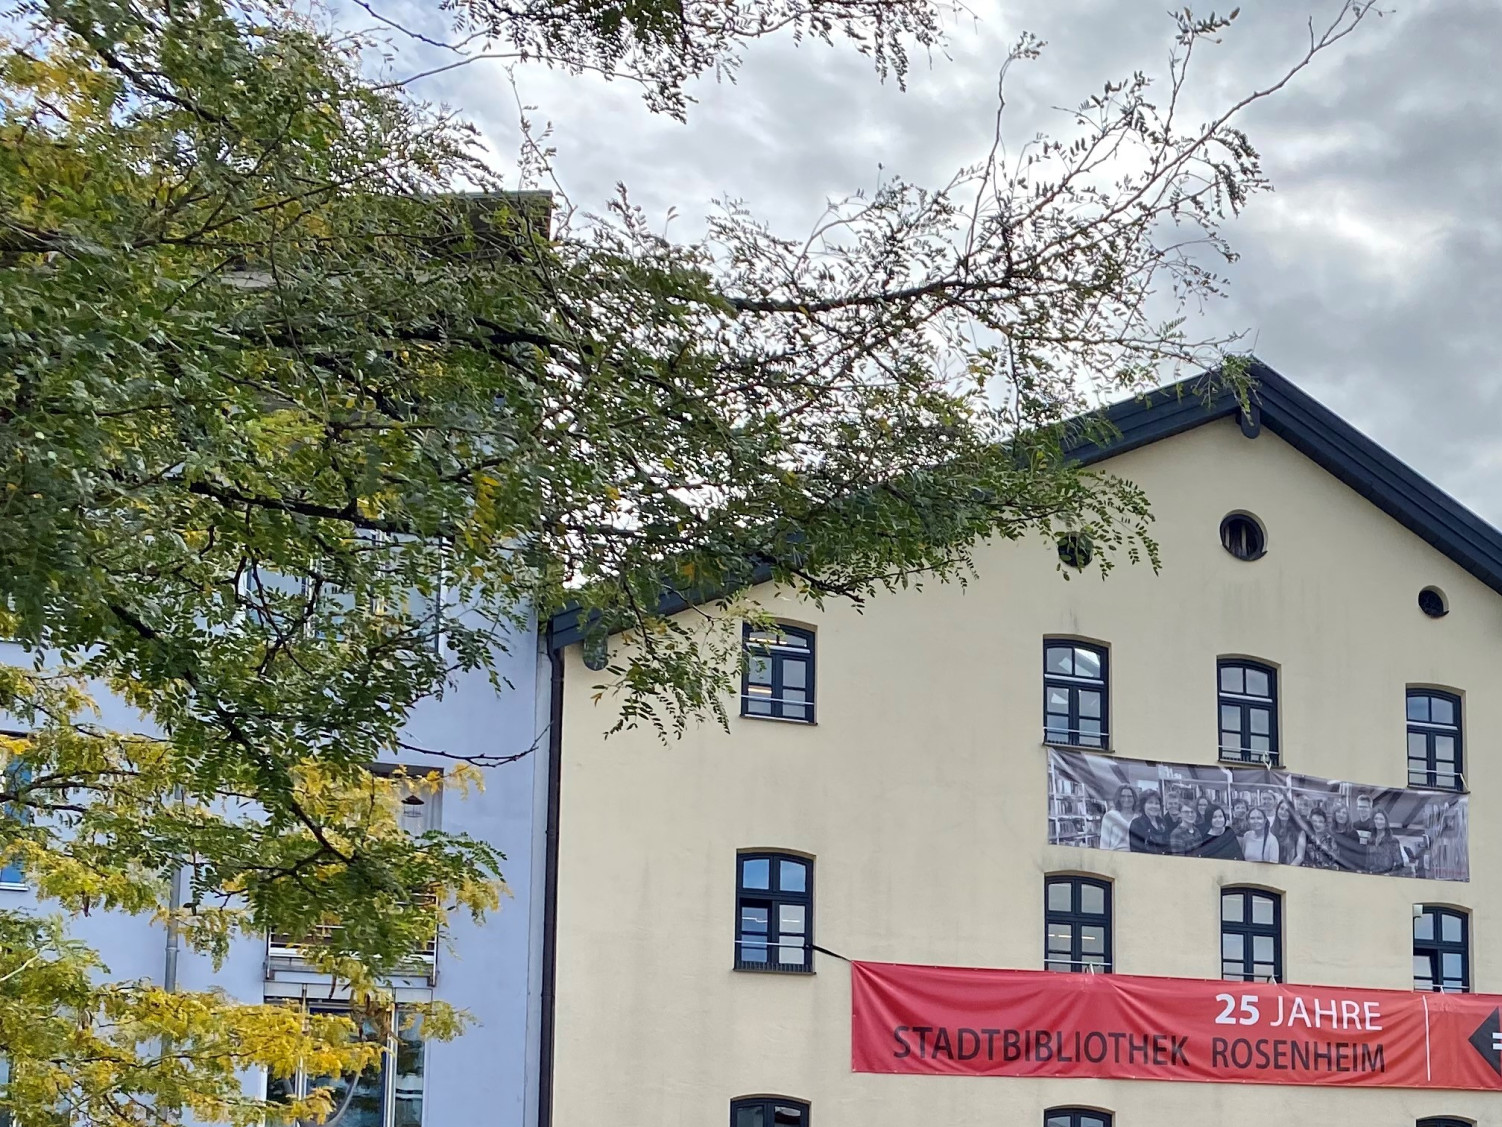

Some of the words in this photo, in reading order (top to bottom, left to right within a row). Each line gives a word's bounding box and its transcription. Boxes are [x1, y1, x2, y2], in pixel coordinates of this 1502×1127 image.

[1215, 994, 1260, 1026] 25
[1271, 996, 1383, 1032] JAHRE
[893, 1025, 1190, 1067] STADTBIBLIOTHEK
[1212, 1037, 1386, 1073] ROSENHEIM
